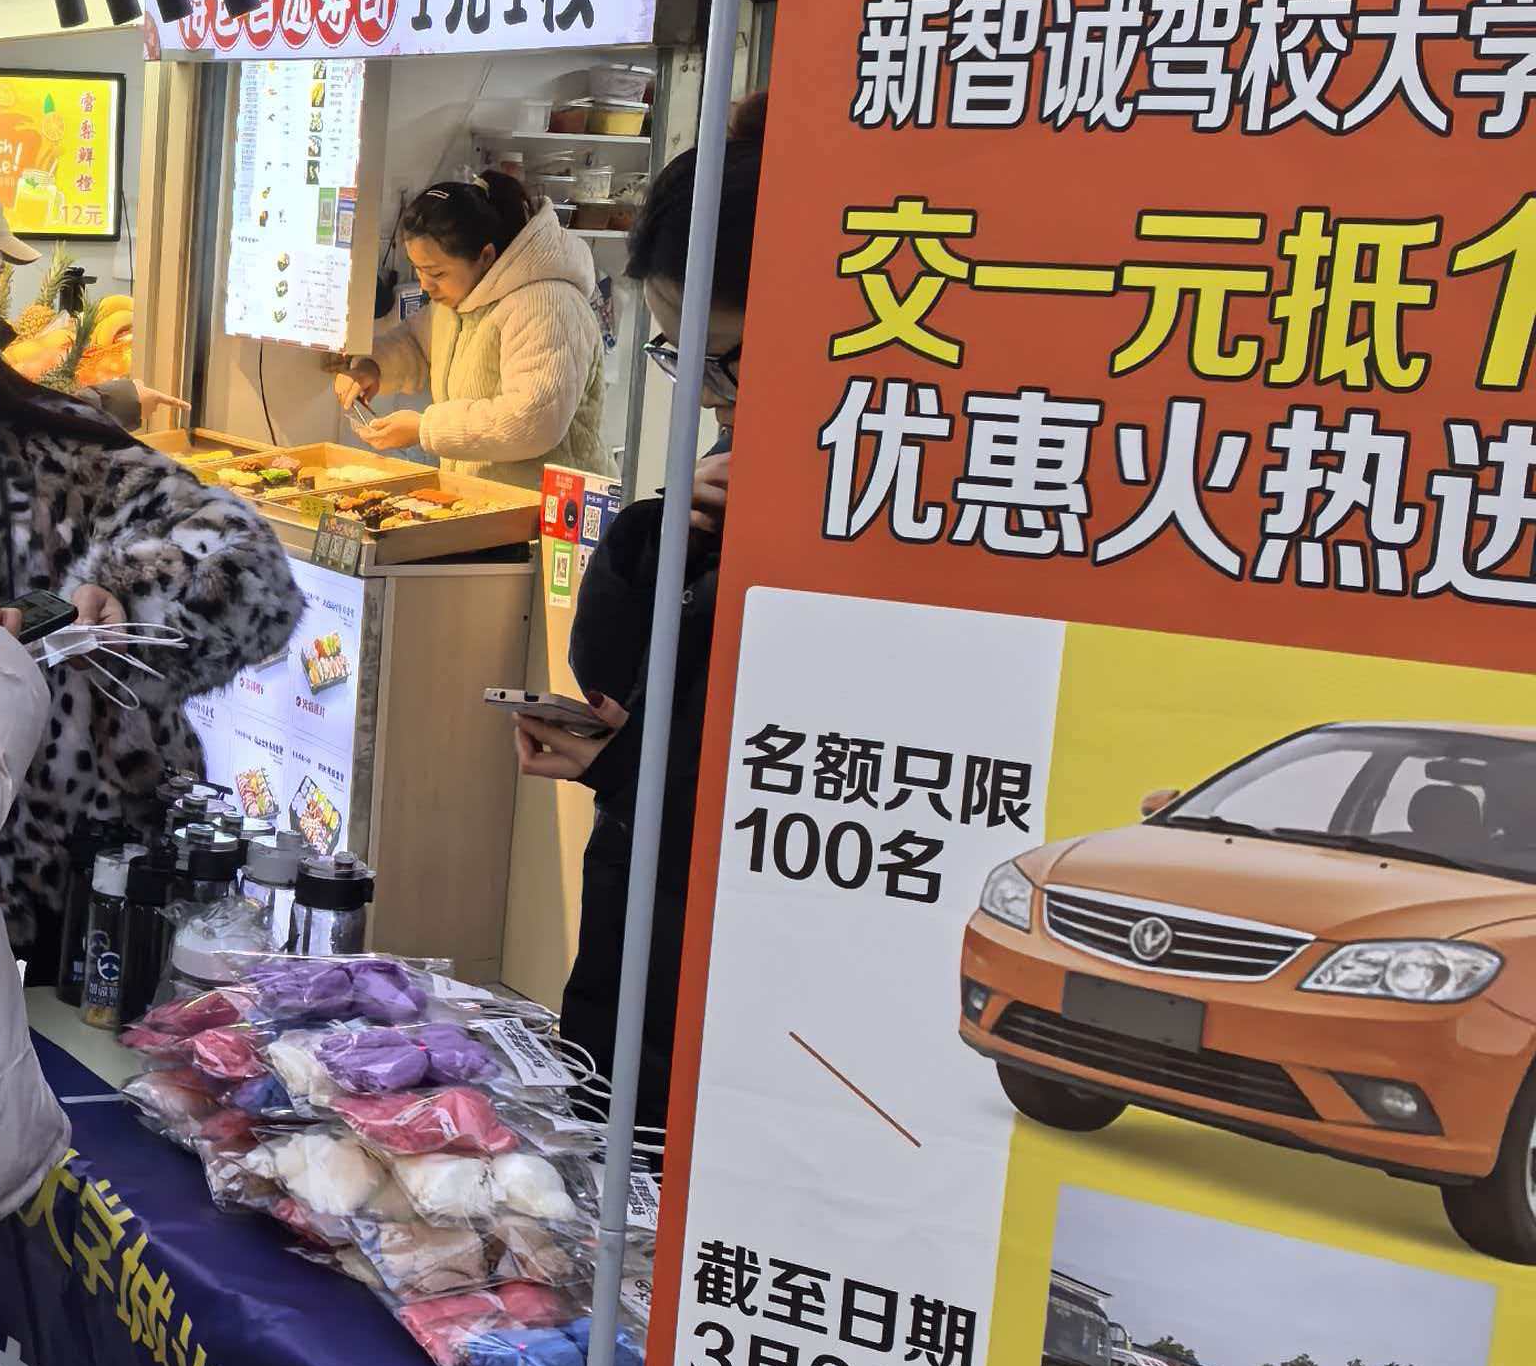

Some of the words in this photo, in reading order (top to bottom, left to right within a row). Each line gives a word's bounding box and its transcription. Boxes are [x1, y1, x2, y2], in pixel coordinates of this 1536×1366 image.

[62, 205, 104, 226] 12元
[742, 723, 1033, 833] 名额只限
[734, 809, 945, 905] 100名
